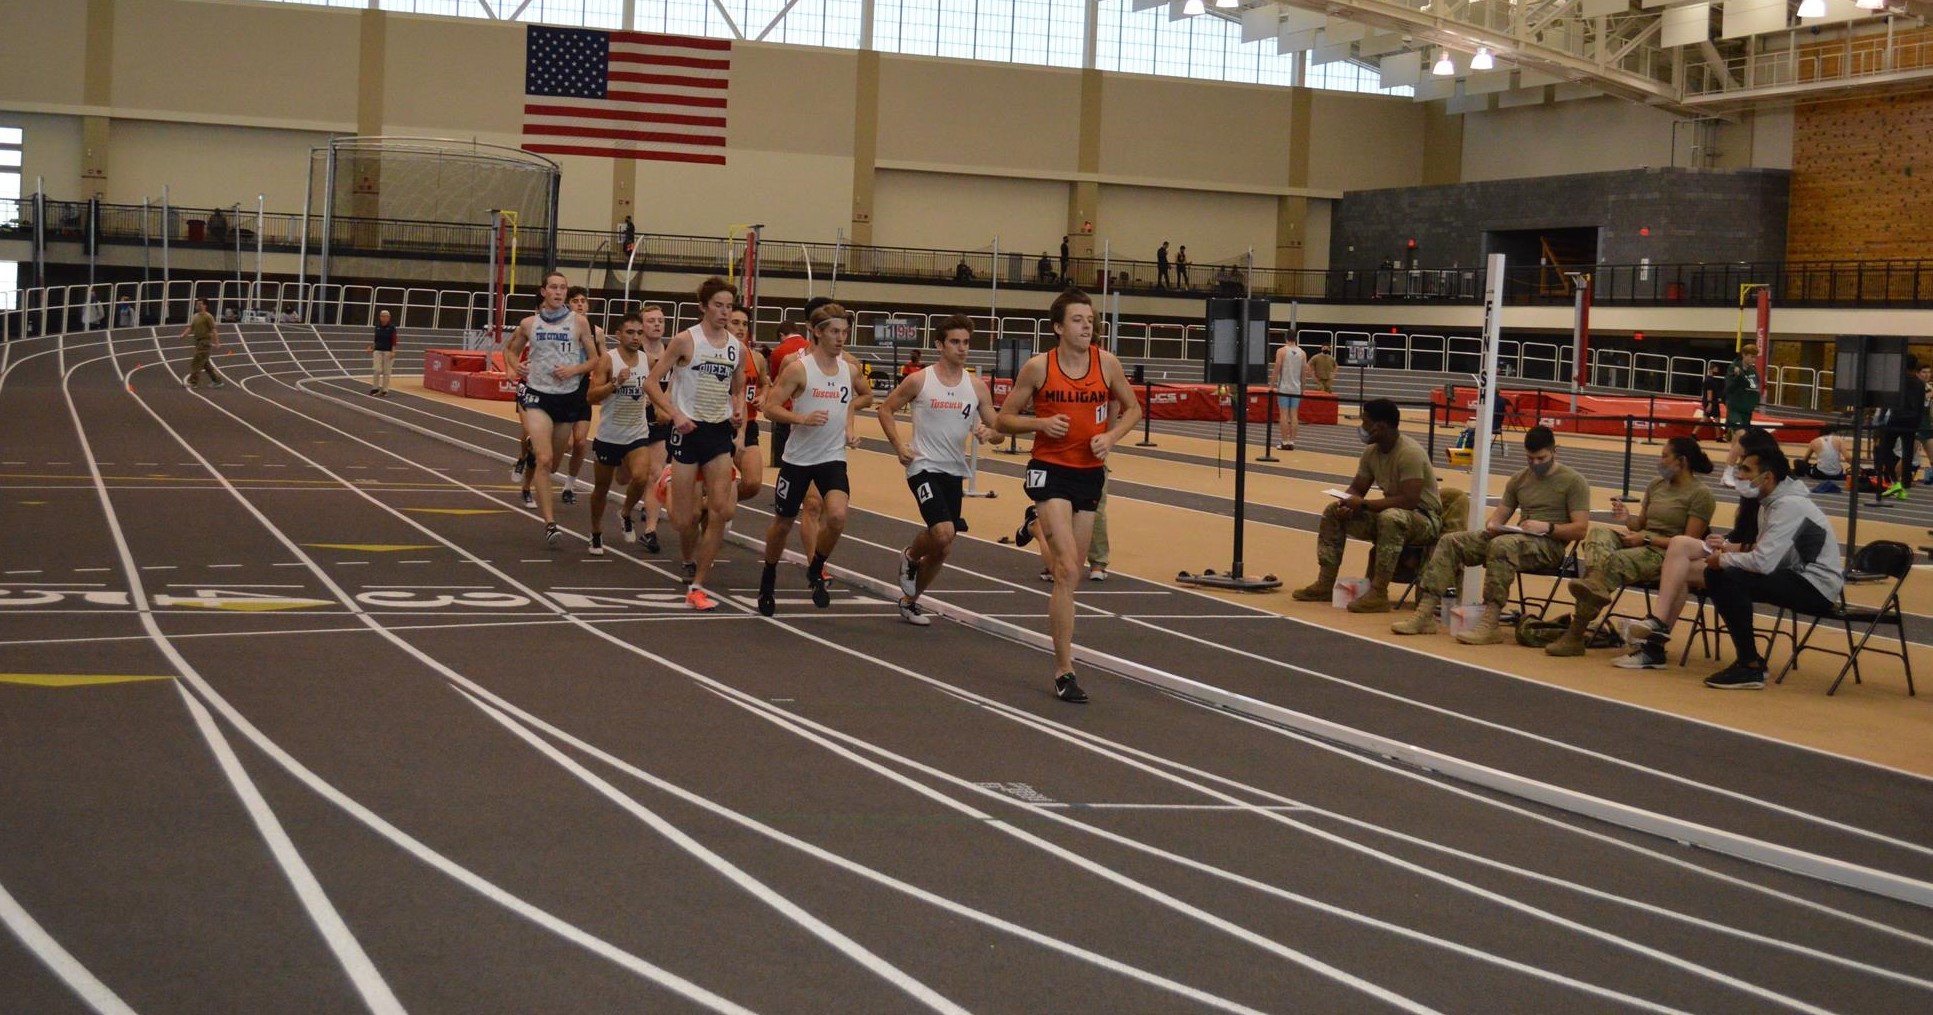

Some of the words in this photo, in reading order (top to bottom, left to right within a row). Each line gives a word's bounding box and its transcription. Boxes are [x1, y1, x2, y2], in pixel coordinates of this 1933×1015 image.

[561, 342, 571, 352] 11
[727, 345, 736, 361] 6
[1479, 300, 1492, 405] FINISH
[746, 386, 755, 401] 5
[840, 386, 849, 404] 2
[1045, 390, 1106, 403] MILLIGAN
[961, 403, 971, 420] 4
[670, 427, 681, 444] 6
[1027, 470, 1044, 487] 17
[778, 479, 787, 497] 2
[920, 484, 930, 499] 4
[355, 591, 531, 607] 3
